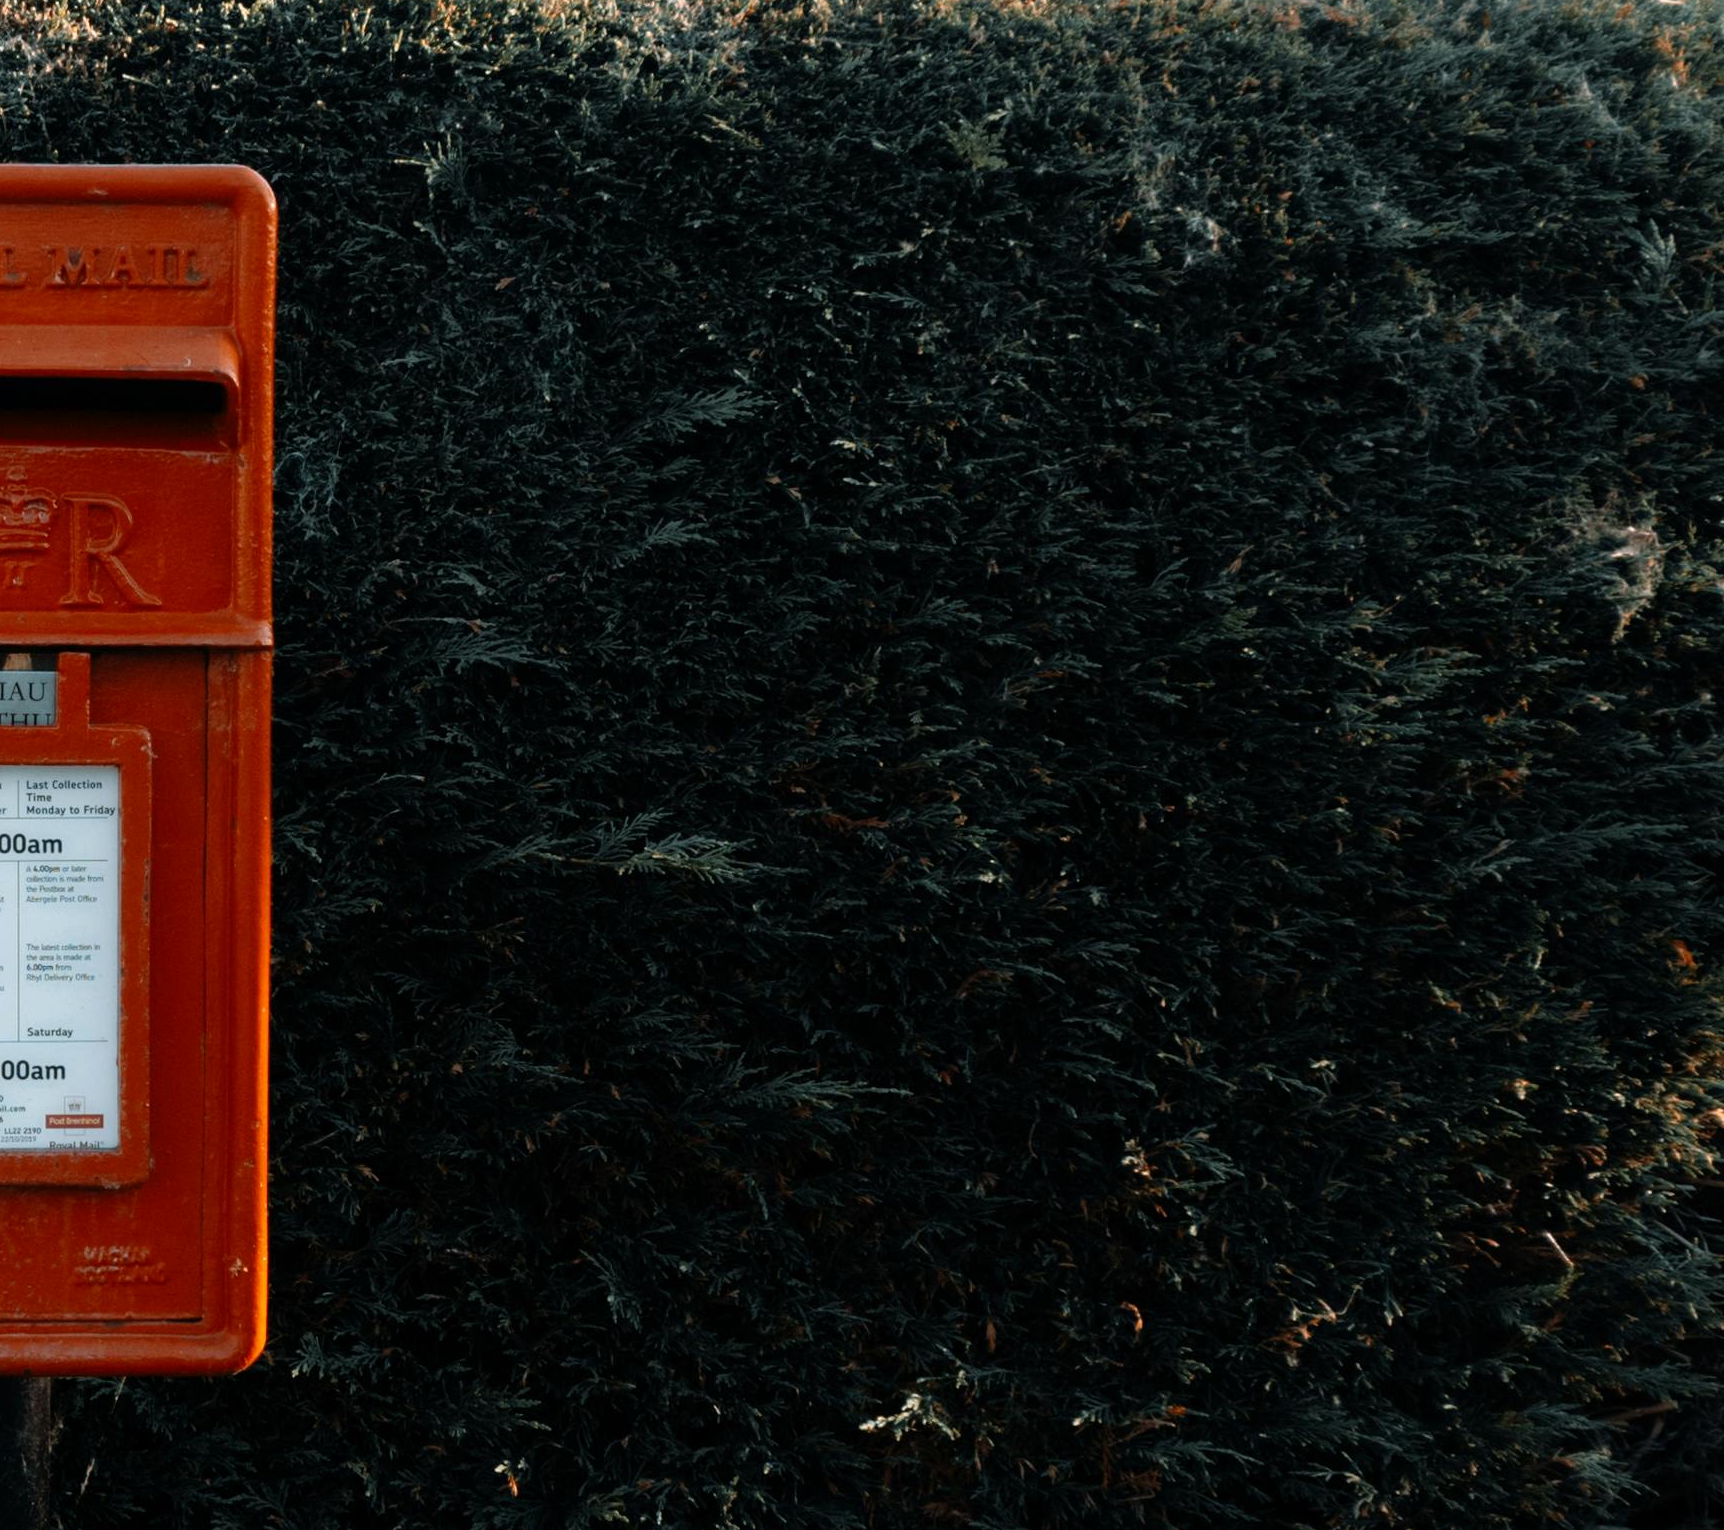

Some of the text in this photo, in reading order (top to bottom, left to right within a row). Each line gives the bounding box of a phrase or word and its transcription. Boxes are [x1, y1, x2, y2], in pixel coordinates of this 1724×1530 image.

[42, 240, 211, 289] MAIL
[26, 779, 102, 789] Last Collection
[26, 793, 52, 802] Time
[26, 806, 66, 816] Monday
[84, 805, 116, 816] Friday
[26, 973, 95, 982] Rhyl Delivery Office
[27, 1028, 73, 1038] Saturday
[49, 1117, 64, 1125] Post
[50, 1141, 75, 1149] Royal
